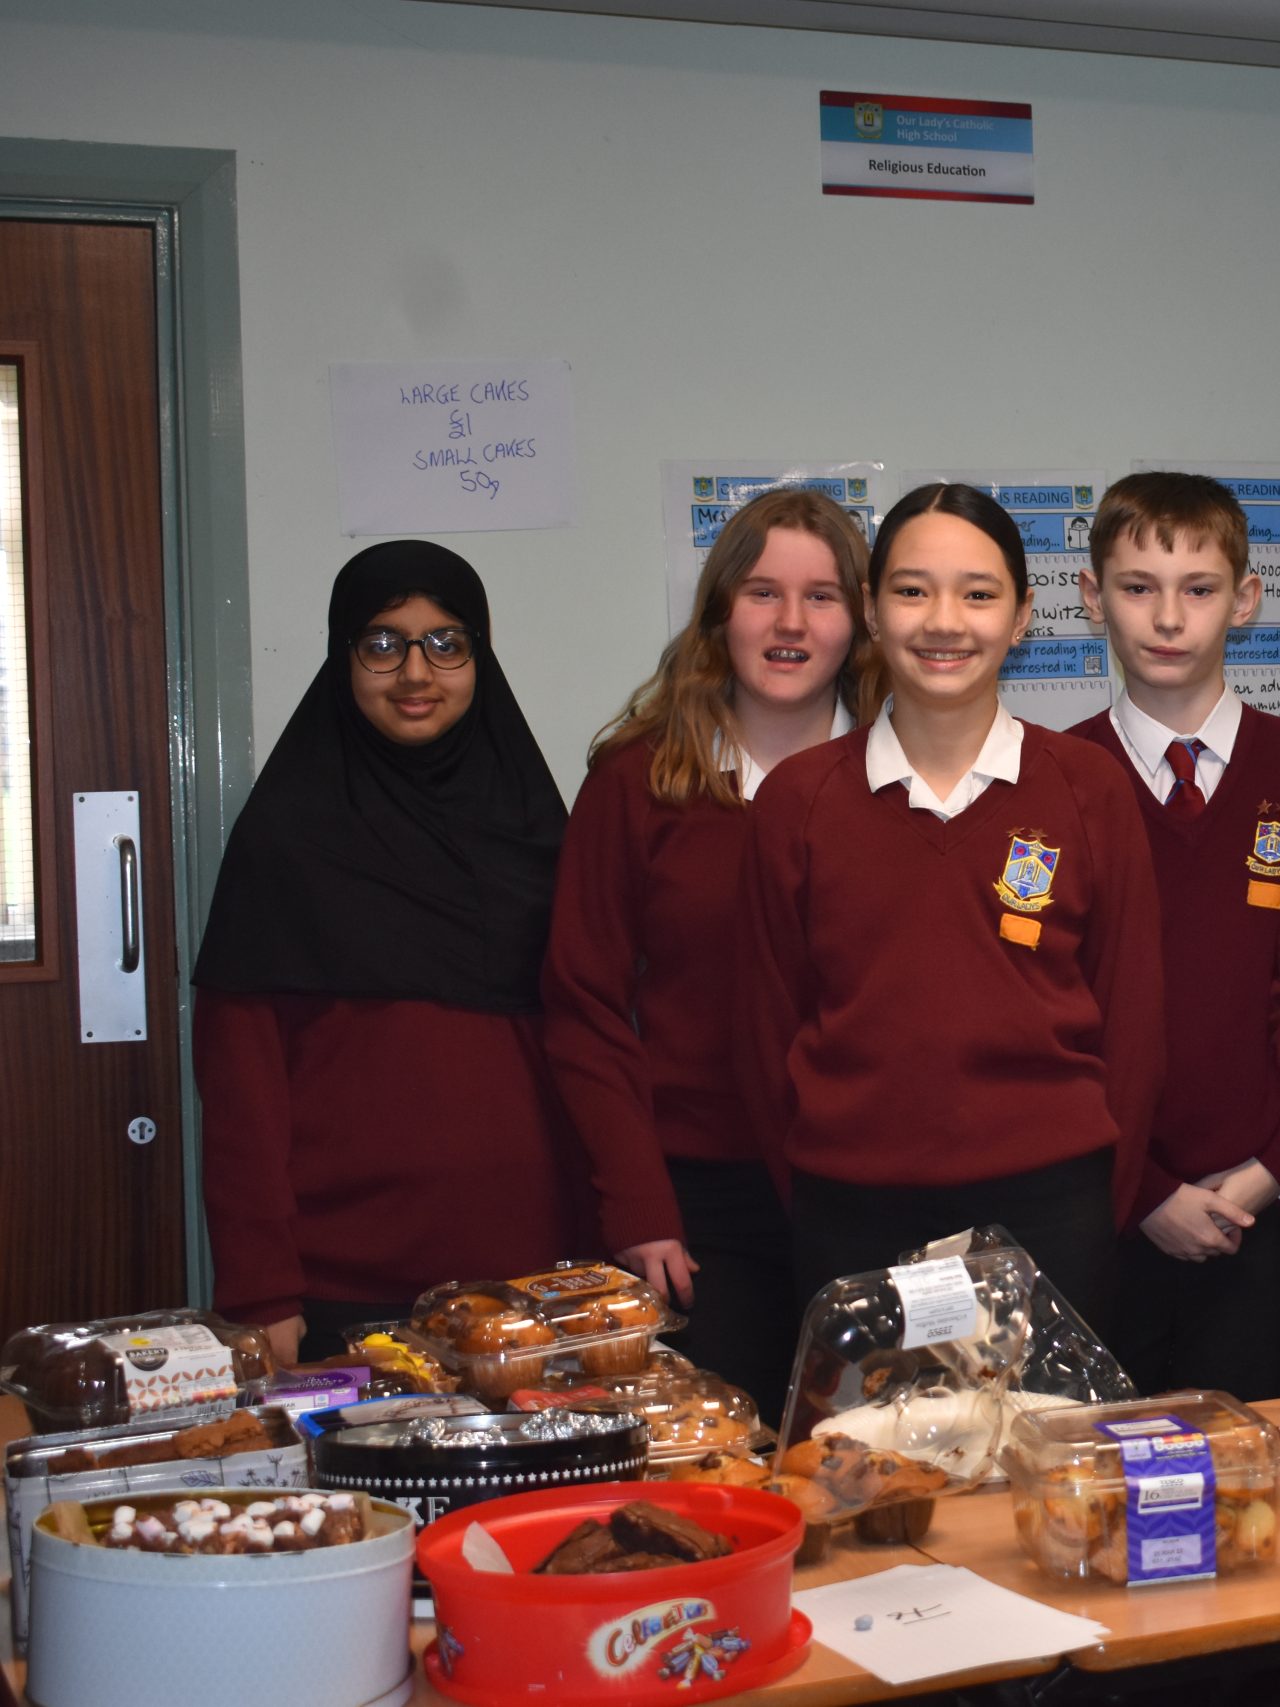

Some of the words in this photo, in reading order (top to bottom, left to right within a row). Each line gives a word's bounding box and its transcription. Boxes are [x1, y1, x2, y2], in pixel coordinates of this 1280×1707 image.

[896, 115, 915, 127] Our
[918, 117, 951, 130] Lady's
[952, 119, 994, 131] Catholic
[897, 131, 921, 142] High
[923, 131, 958, 142] School
[869, 159, 924, 175] Religious
[927, 162, 986, 177] Education
[400, 383, 461, 405] LARGE
[470, 379, 530, 404] CAKES
[449, 409, 472, 439] £1
[412, 447, 478, 471] SMALL
[482, 438, 537, 463] CAKES
[460, 470, 499, 500] 50p
[1014, 492, 1070, 504] READING
[698, 508, 726, 524] Mrs
[1247, 525, 1280, 541] ding...
[1027, 570, 1080, 586] ooist
[1025, 626, 1055, 637] orris
[1008, 645, 1031, 658] njoy
[1034, 642, 1077, 659] reading
[1080, 642, 1104, 654] this
[1224, 647, 1279, 659] nterested
[1063, 662, 1076, 673] in:
[1233, 684, 1254, 694] an
[129, 1348, 166, 1358] BAKERY
